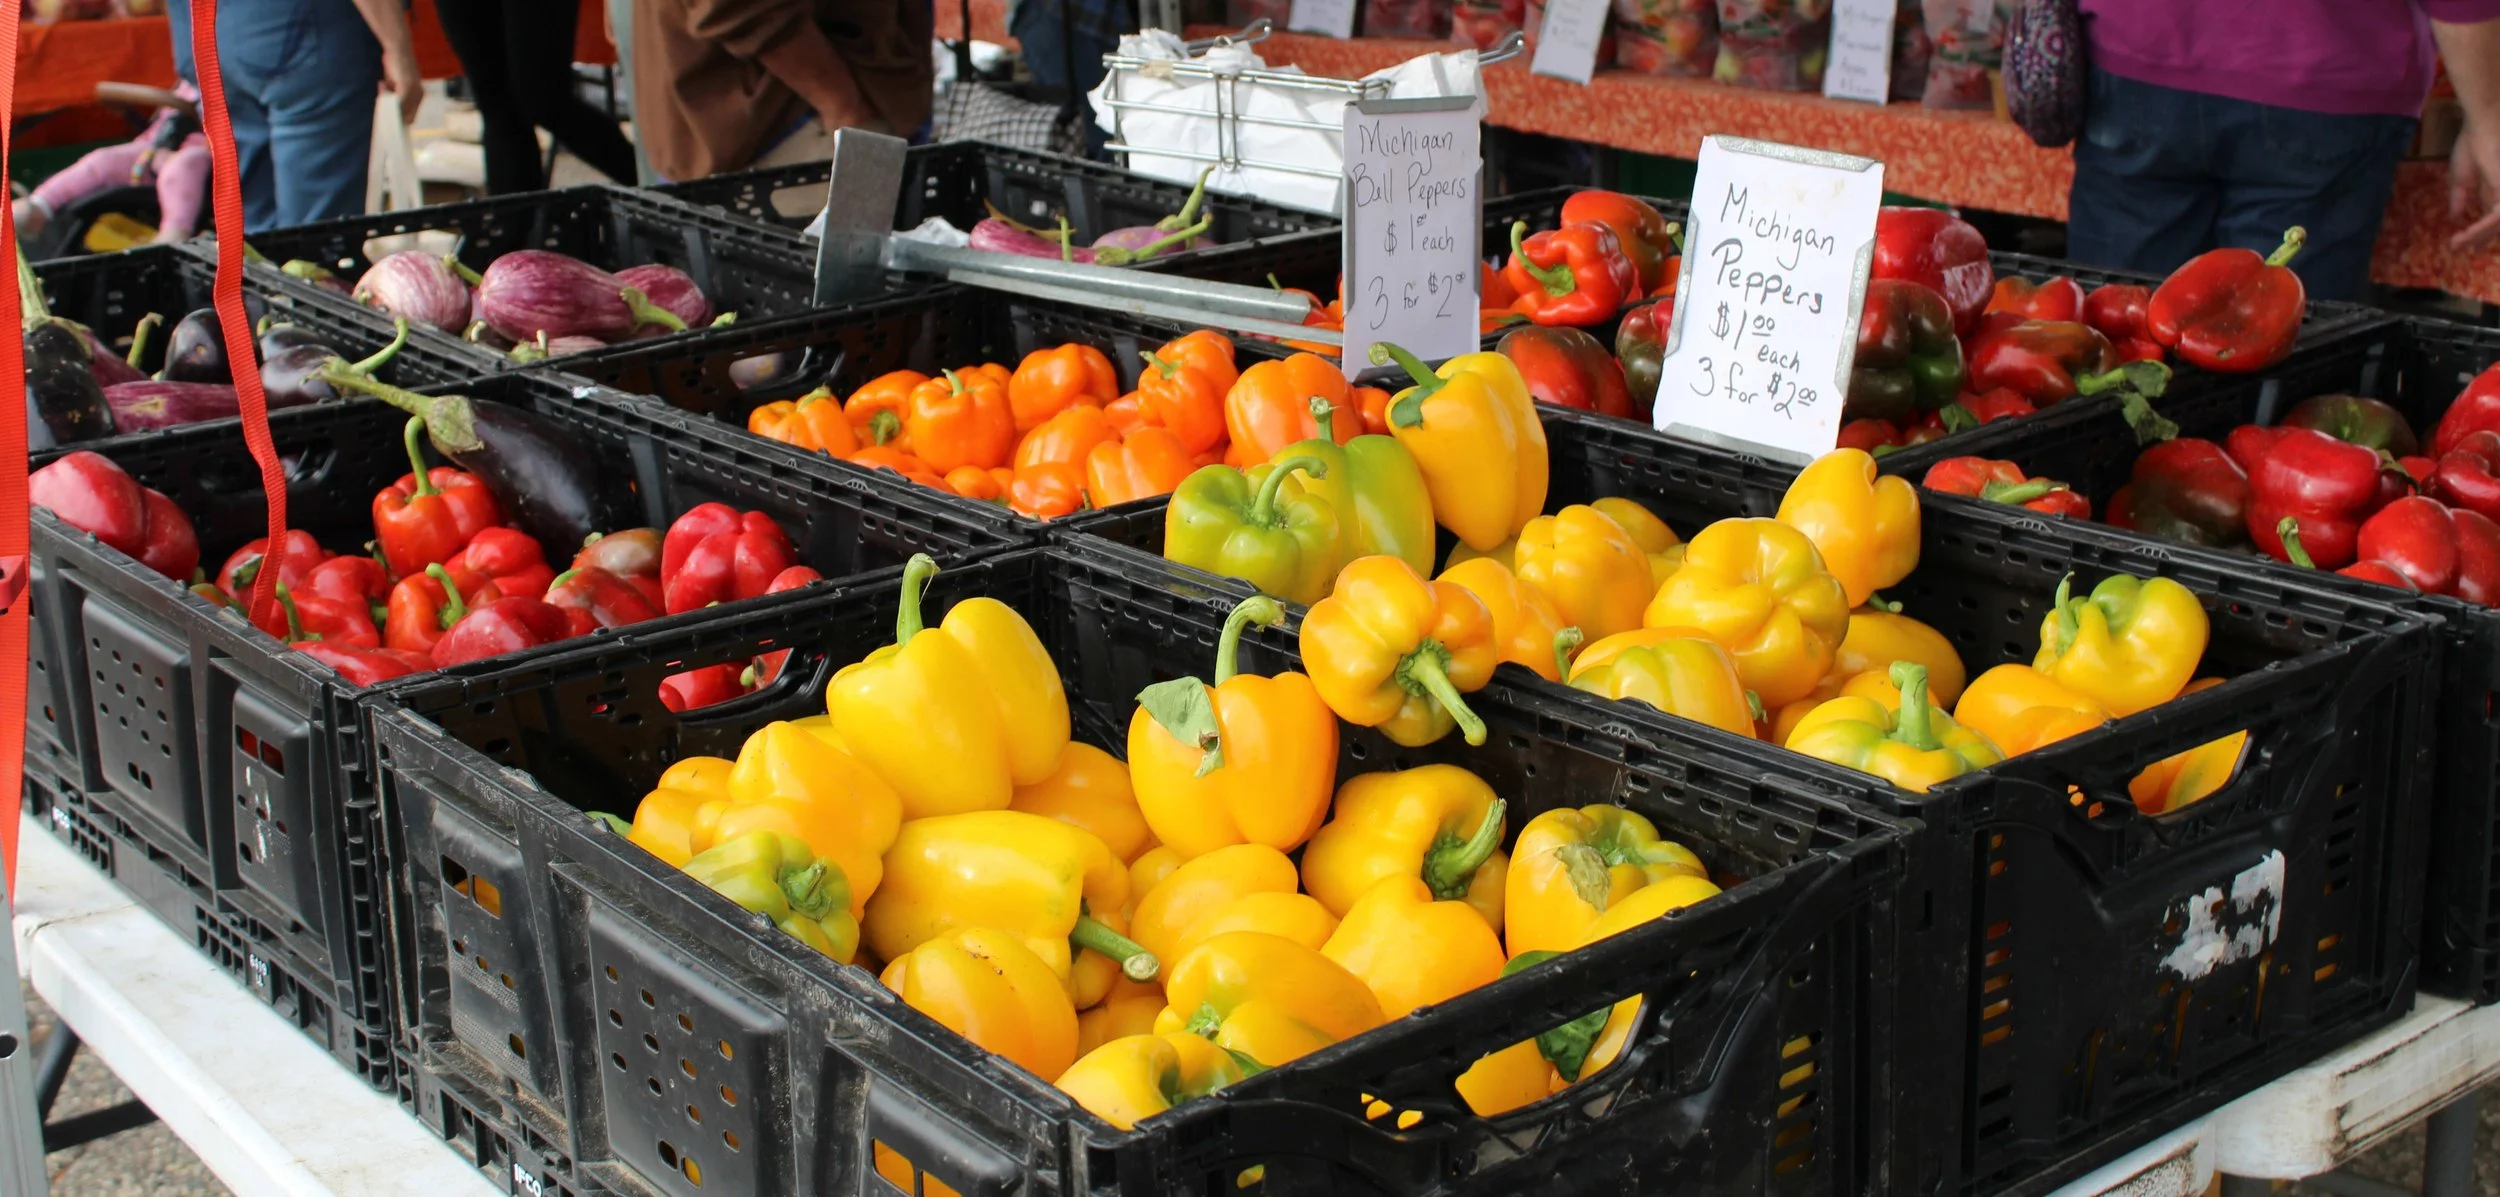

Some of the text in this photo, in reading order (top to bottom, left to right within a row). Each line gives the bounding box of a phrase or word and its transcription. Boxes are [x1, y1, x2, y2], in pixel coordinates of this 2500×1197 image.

[1359, 120, 1453, 176] Michigan
[1353, 161, 1466, 210] Bell Peppers
[1422, 226, 1454, 252] each
[1721, 183, 1835, 271] Michigan
[1368, 276, 1389, 330] 3
[1404, 282, 1420, 310] for
[1690, 357, 1715, 397] 3
[1724, 361, 1759, 405] for
[1757, 344, 1800, 373] each
[513, 1163, 542, 1197] IFCO
